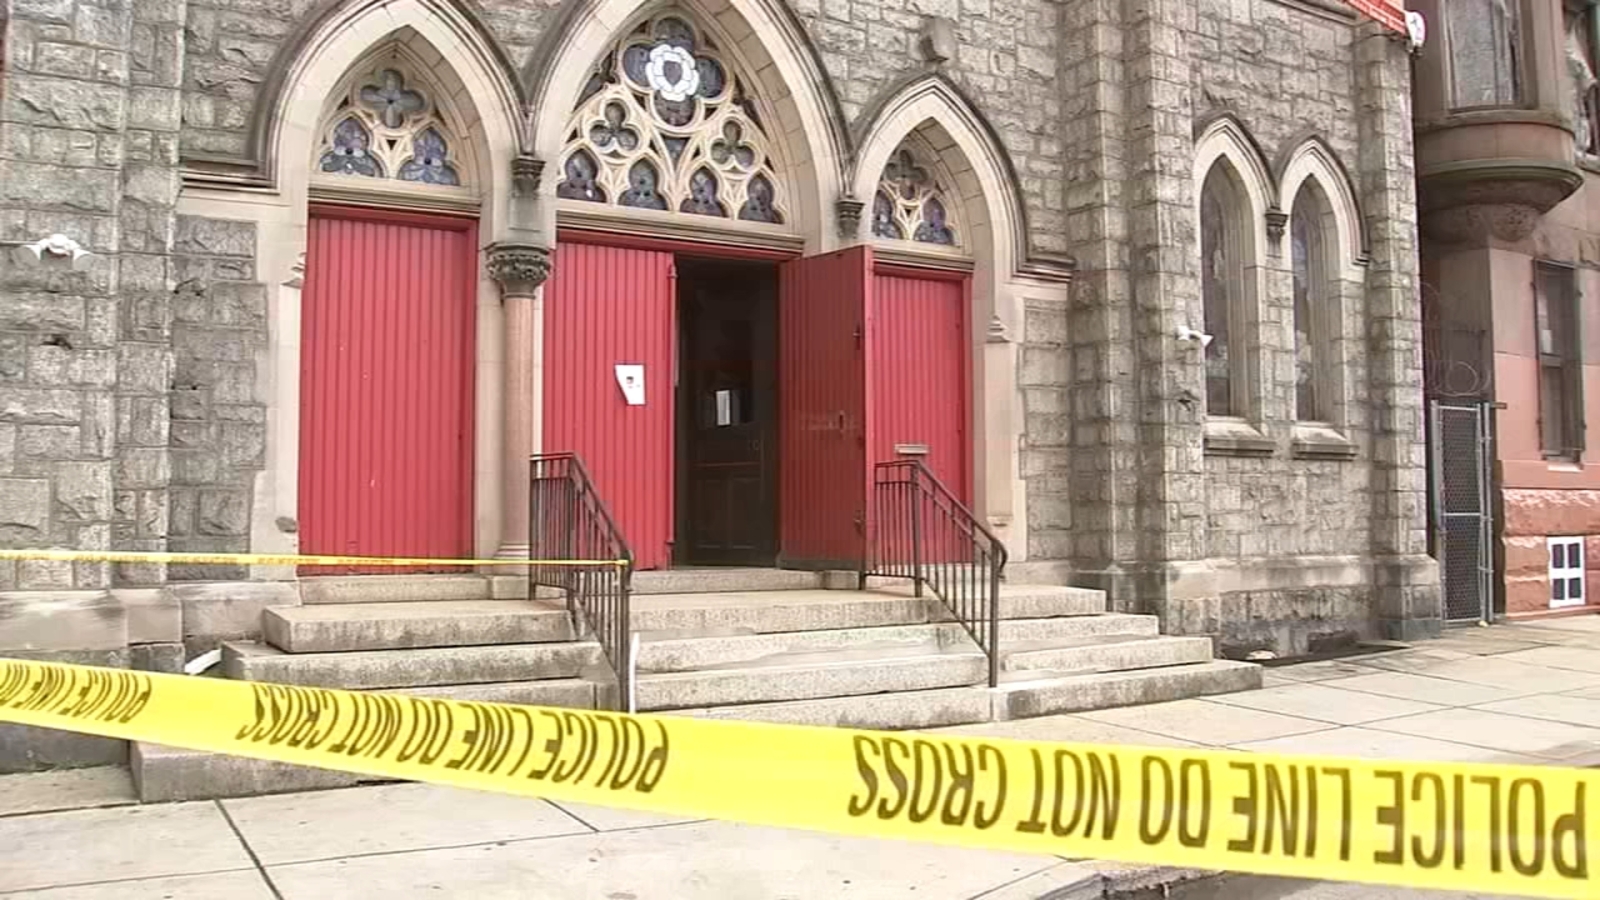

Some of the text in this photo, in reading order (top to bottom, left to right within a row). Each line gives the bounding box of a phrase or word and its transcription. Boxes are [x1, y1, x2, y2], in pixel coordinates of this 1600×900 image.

[11, 665, 76, 713] LINE
[57, 675, 152, 724] POLICE
[235, 683, 669, 793] POLICE LINE DO NOT CROSS
[848, 735, 1589, 880] POLICE LINE DO NOT CROSS
